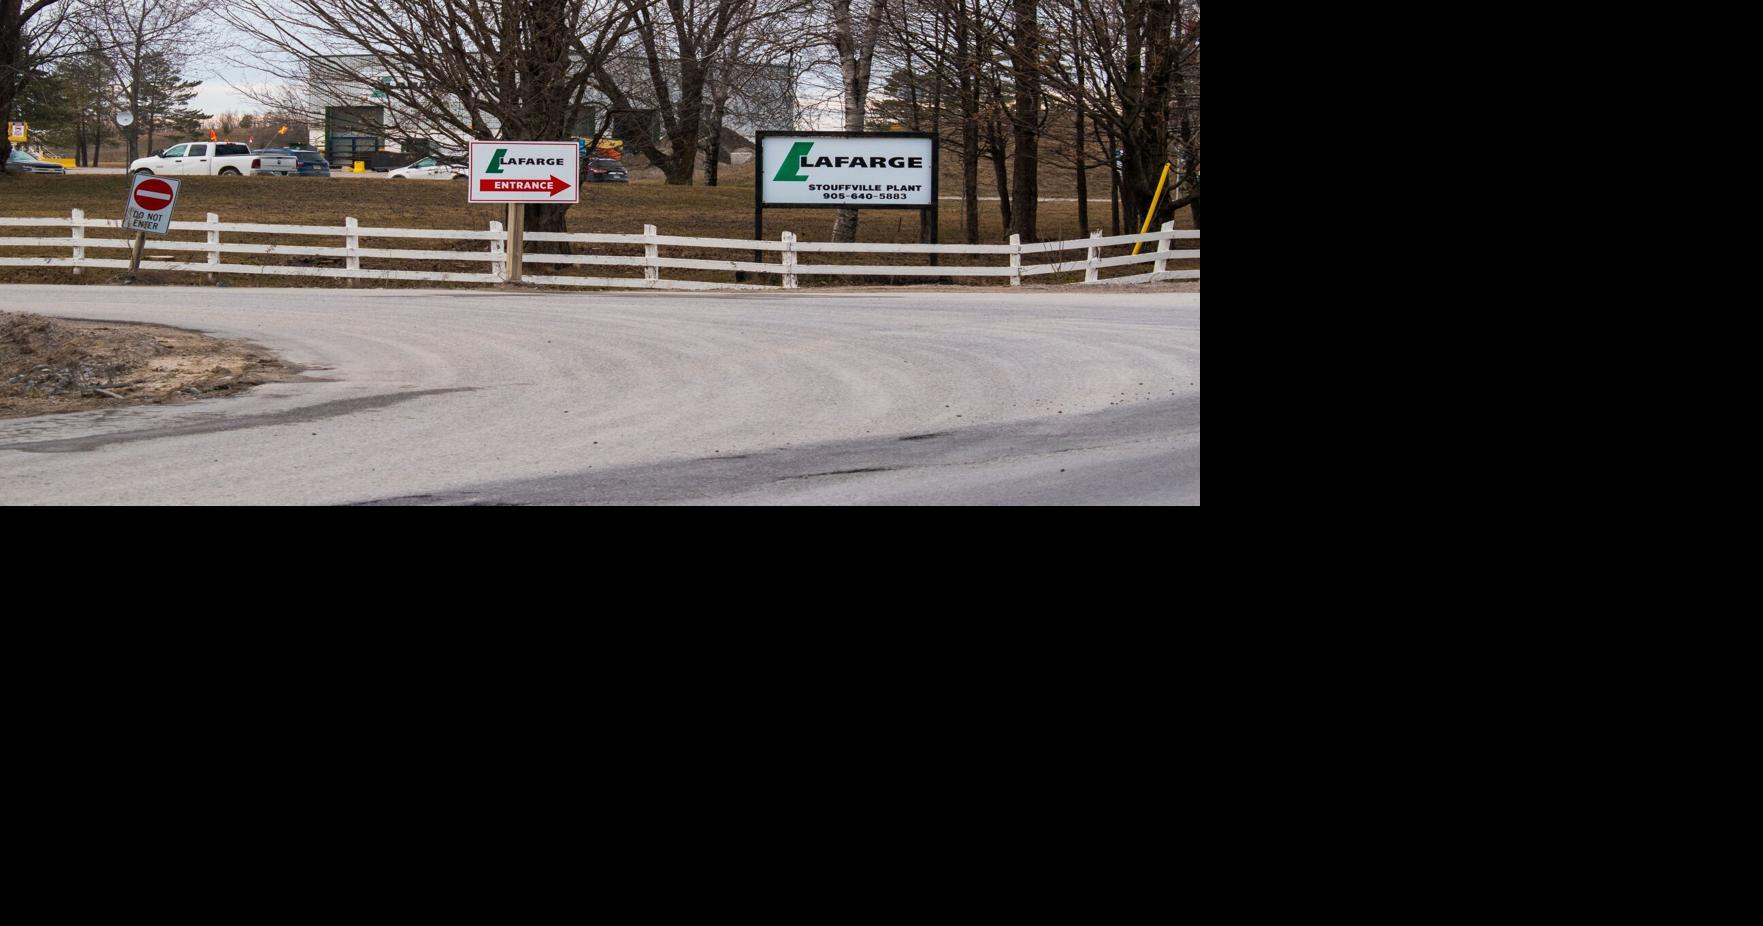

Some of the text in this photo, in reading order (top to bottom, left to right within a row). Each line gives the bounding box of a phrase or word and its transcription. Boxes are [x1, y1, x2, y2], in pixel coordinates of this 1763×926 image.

[500, 157, 564, 166] LAFARGE
[800, 156, 923, 168] LAFARGE
[494, 181, 554, 190] ENTRANCE
[808, 184, 922, 192] STOUFFVILLE PLANT
[823, 192, 907, 200] 905-640-5883
[132, 211, 163, 222] DO NOT
[132, 219, 159, 229] ENTER
